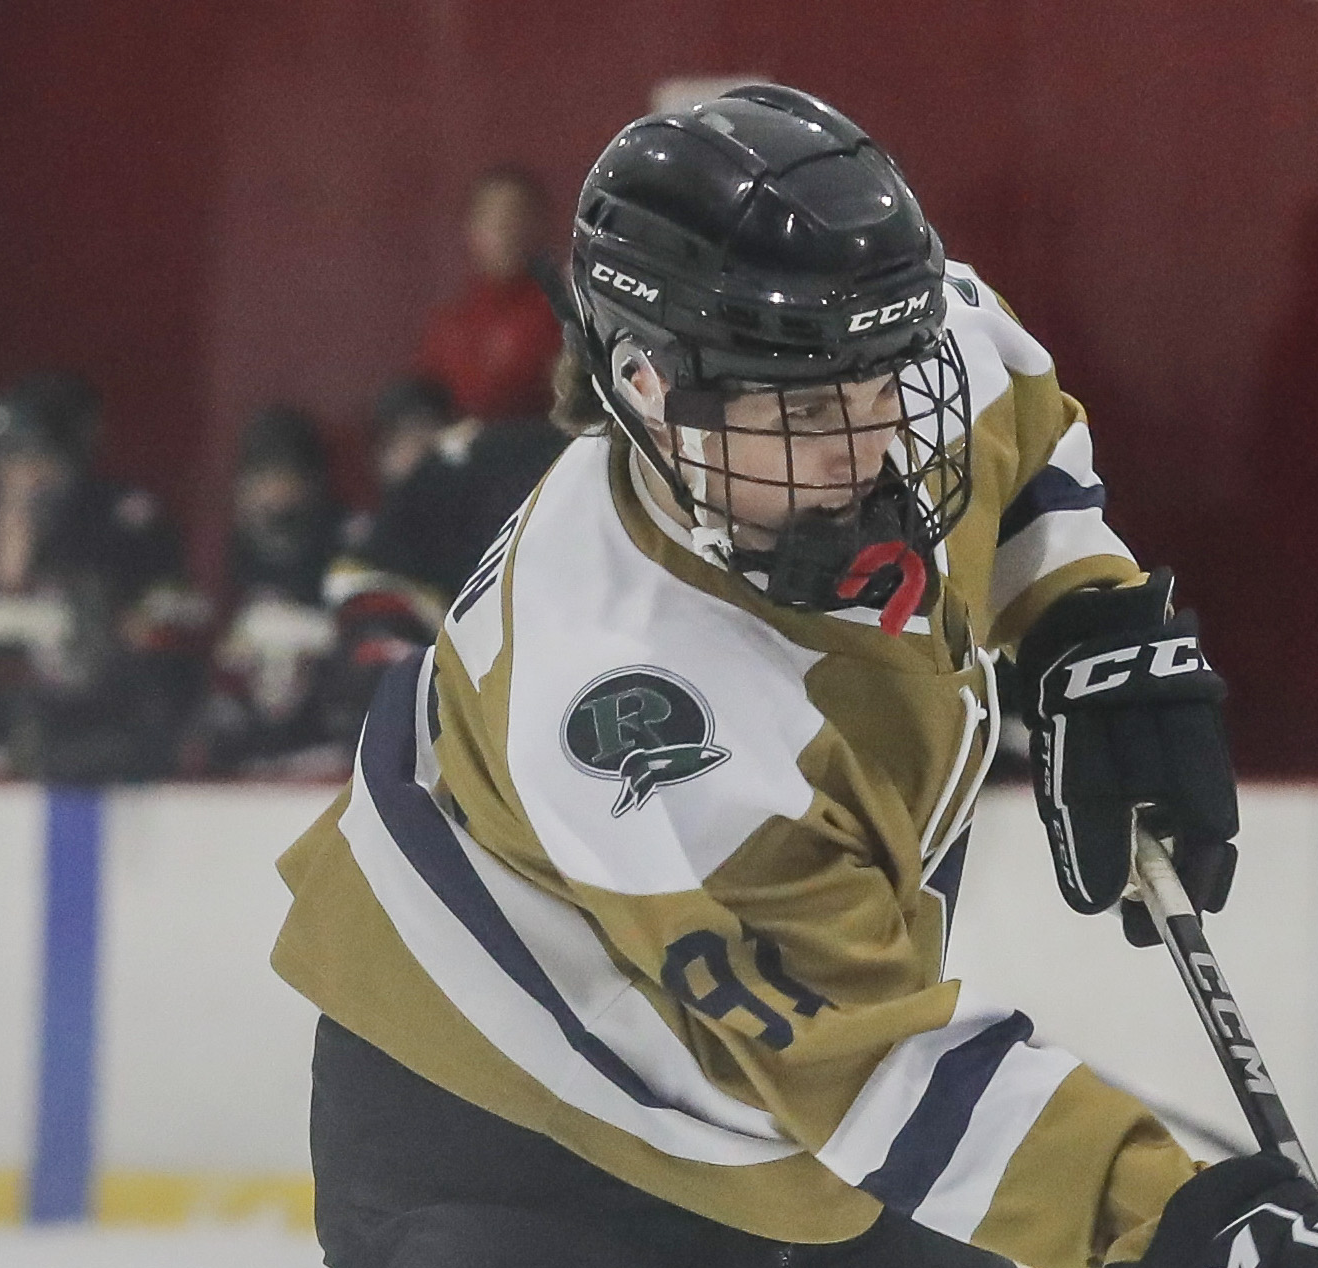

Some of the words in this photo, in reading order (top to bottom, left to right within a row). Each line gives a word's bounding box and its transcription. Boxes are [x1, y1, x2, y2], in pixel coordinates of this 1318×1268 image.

[591, 260, 660, 303] CCM
[847, 288, 931, 333] CCM
[1063, 636, 1213, 700] CC
[1188, 951, 1279, 1096] CCM
